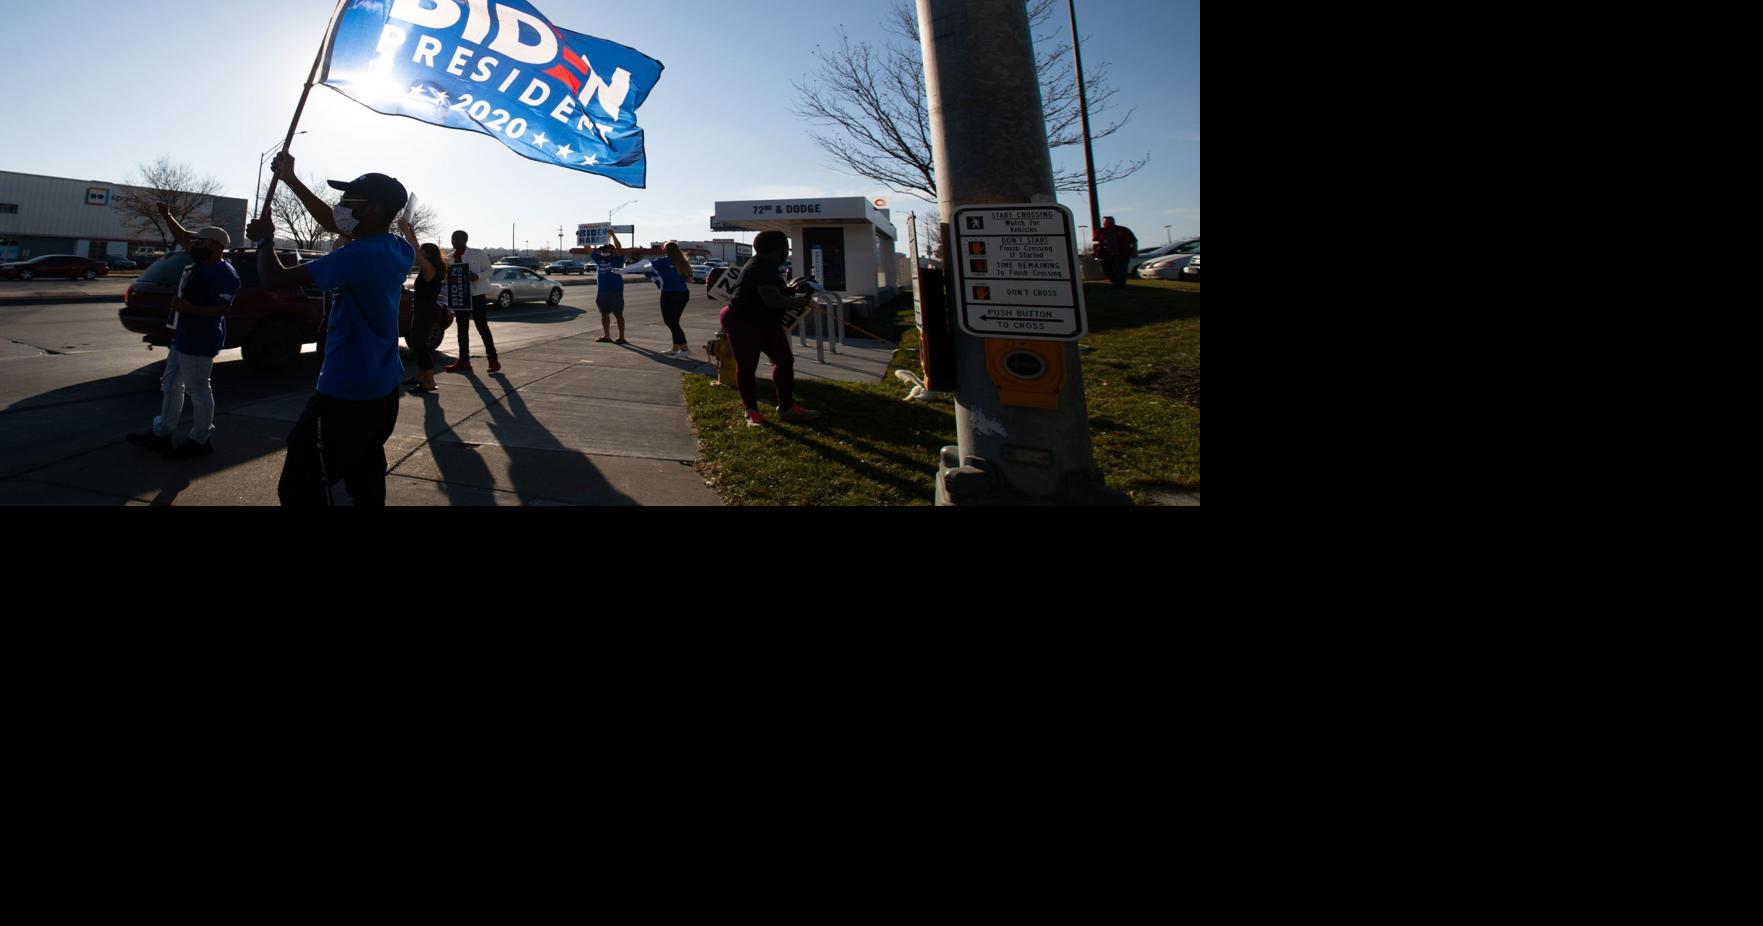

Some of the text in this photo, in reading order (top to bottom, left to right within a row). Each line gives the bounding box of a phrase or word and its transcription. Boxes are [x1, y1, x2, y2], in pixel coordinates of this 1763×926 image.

[450, 94, 528, 140] 2020
[775, 205, 783, 214] &
[786, 203, 822, 214] DODGE
[1032, 270, 1062, 278] Crossing
[1033, 289, 1057, 297] CROSS
[1016, 310, 1053, 318] BUTTON
